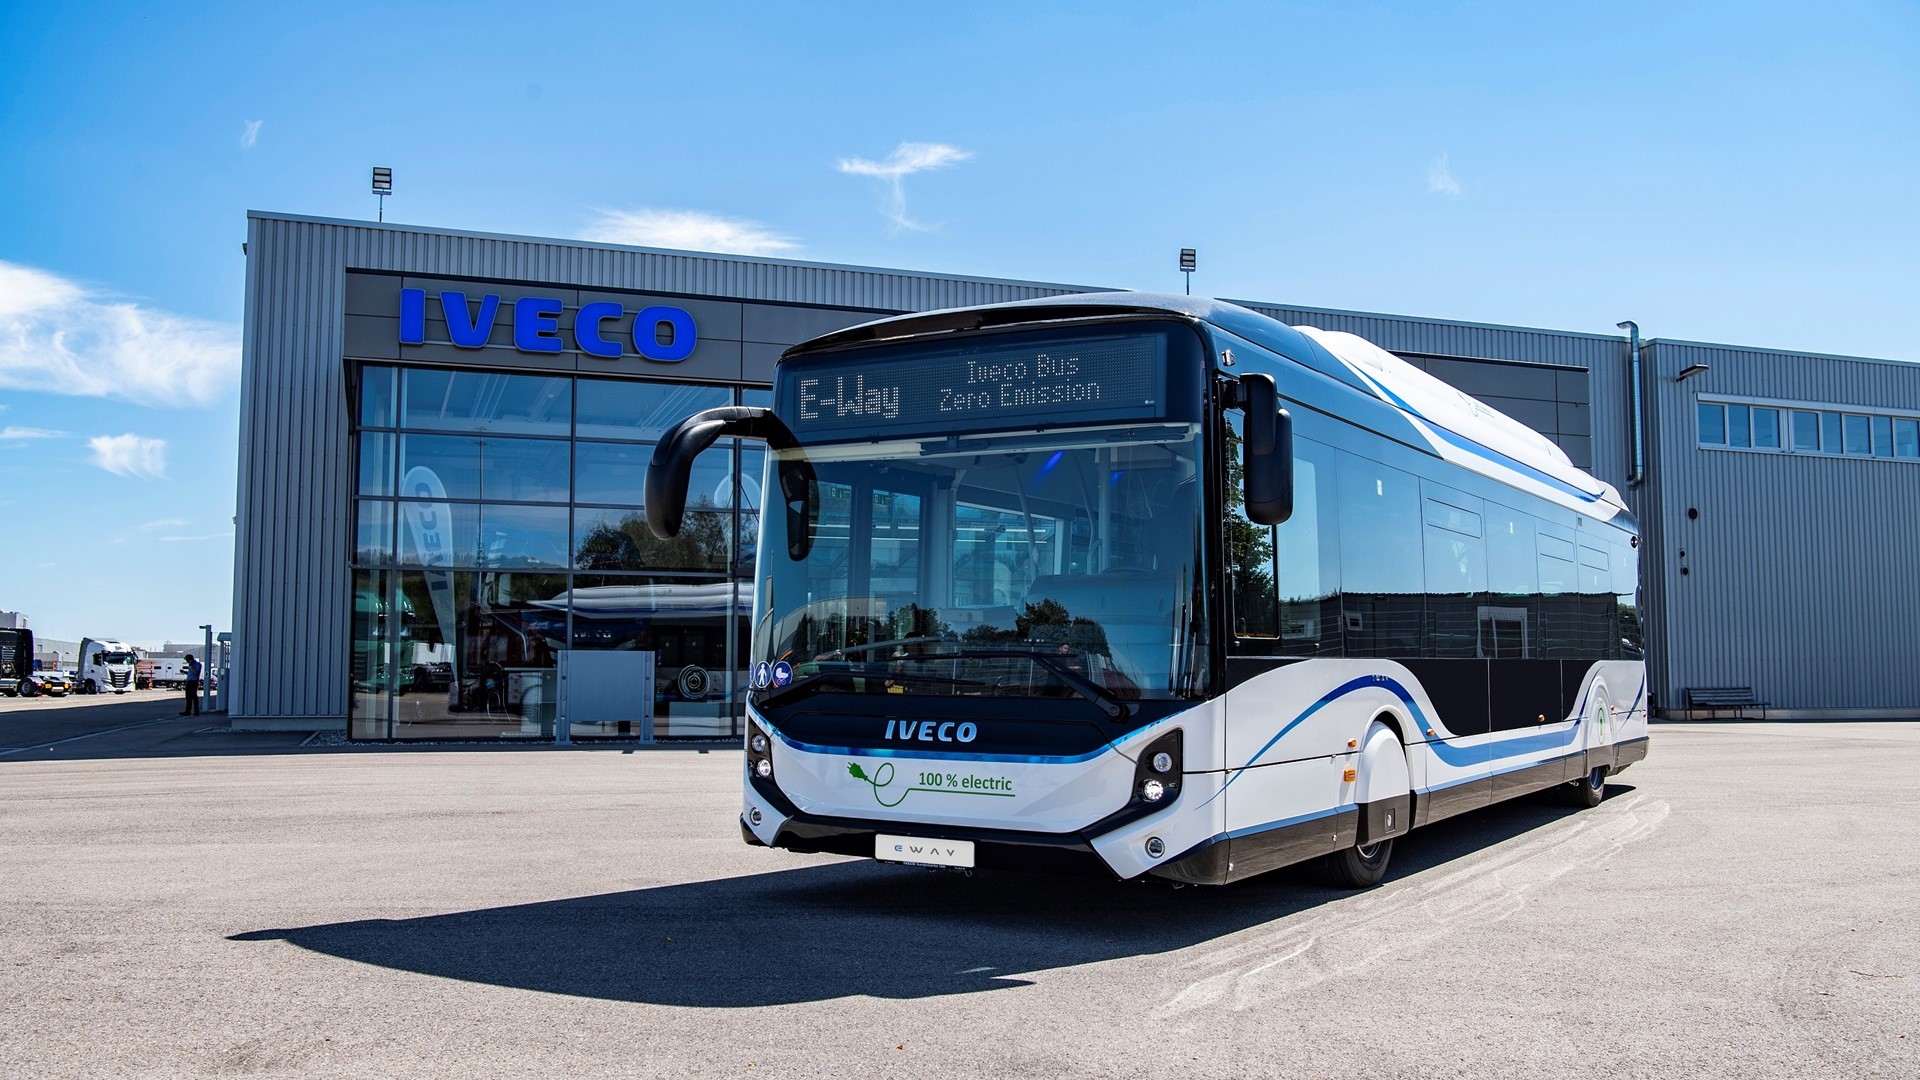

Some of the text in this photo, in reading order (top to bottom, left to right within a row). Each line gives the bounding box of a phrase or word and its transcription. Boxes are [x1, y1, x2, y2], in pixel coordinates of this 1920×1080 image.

[399, 287, 697, 362] IVECO
[967, 354, 1079, 384] Iveco Bus
[800, 375, 899, 419] E-Way
[940, 379, 1100, 412] Zero Emission
[414, 482, 449, 591] IVECO
[885, 720, 977, 743] IVECO
[919, 773, 1012, 791] 100 % electric
